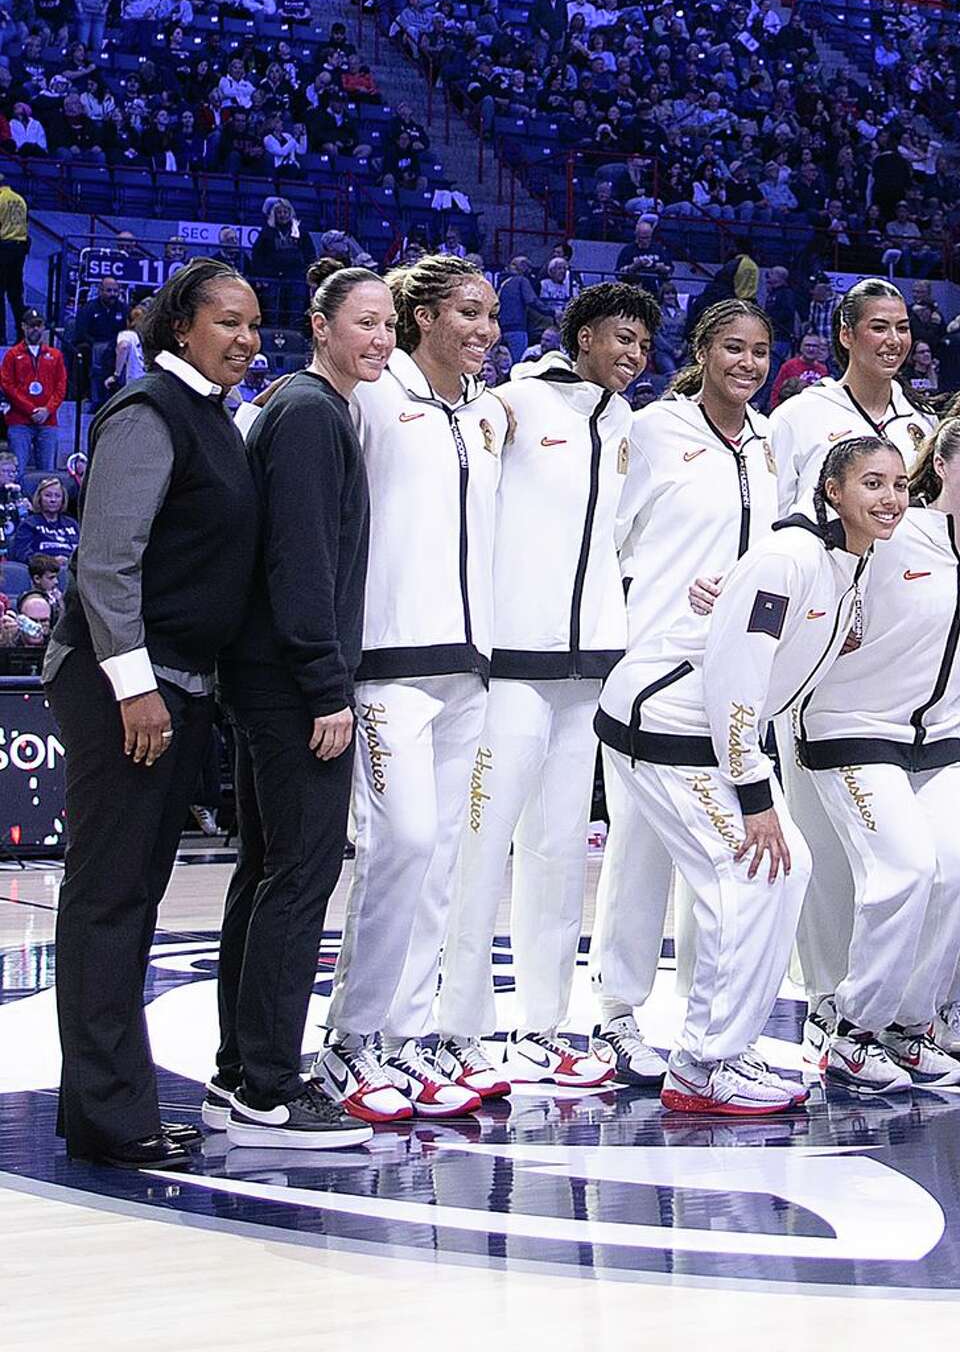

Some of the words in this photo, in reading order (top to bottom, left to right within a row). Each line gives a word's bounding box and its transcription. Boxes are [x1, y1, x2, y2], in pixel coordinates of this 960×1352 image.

[89, 260, 124, 276] SEC
[181, 226, 209, 240] SEC
[361, 702, 392, 795] Huskies
[728, 701, 755, 778] Huskies
[469, 746, 493, 833] Huskies
